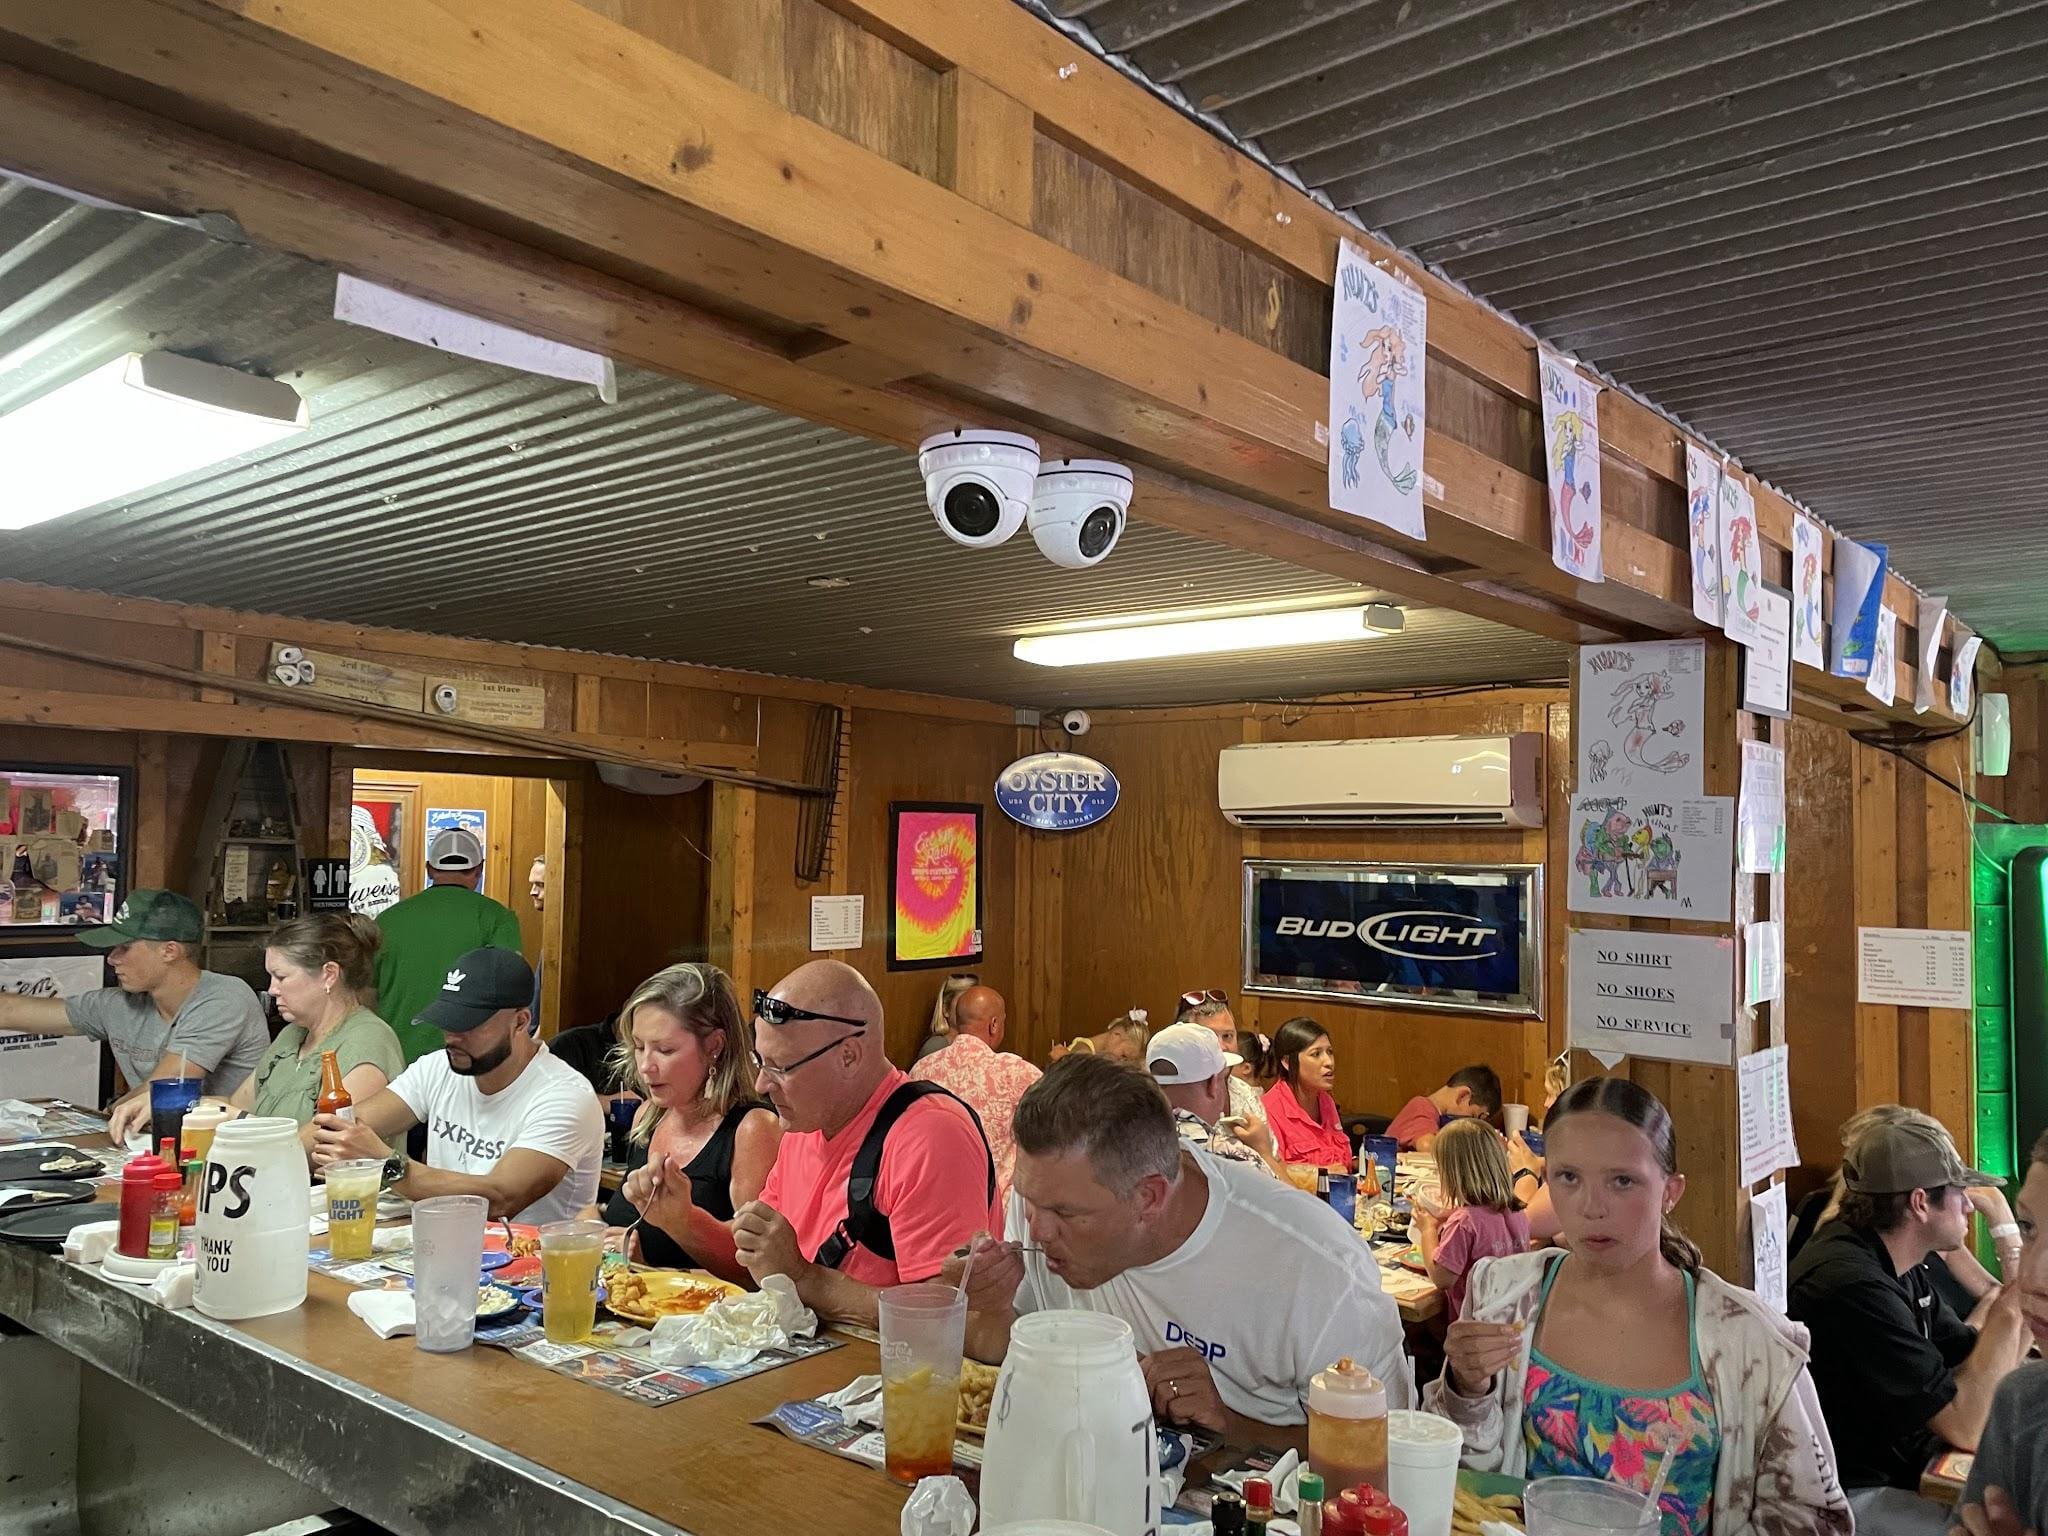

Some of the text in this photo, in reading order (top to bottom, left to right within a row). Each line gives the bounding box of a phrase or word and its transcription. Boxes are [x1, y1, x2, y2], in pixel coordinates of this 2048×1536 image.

[482, 684, 520, 693] 1st Place
[1008, 768, 1106, 792] OYSTER
[1028, 793, 1088, 814] CITY
[1276, 916, 1497, 946] BUD LIGHT
[1597, 950, 1672, 967] NO SHIRT
[1597, 982, 1675, 1001] NO SHOES
[1597, 1015, 1692, 1036] NO SERVICE
[432, 1115, 505, 1160] EXPRESS
[331, 1199, 361, 1210] BUD
[329, 1208, 366, 1221] LIGHT
[201, 1236, 232, 1256] THANK
[206, 1255, 230, 1273] YOU
